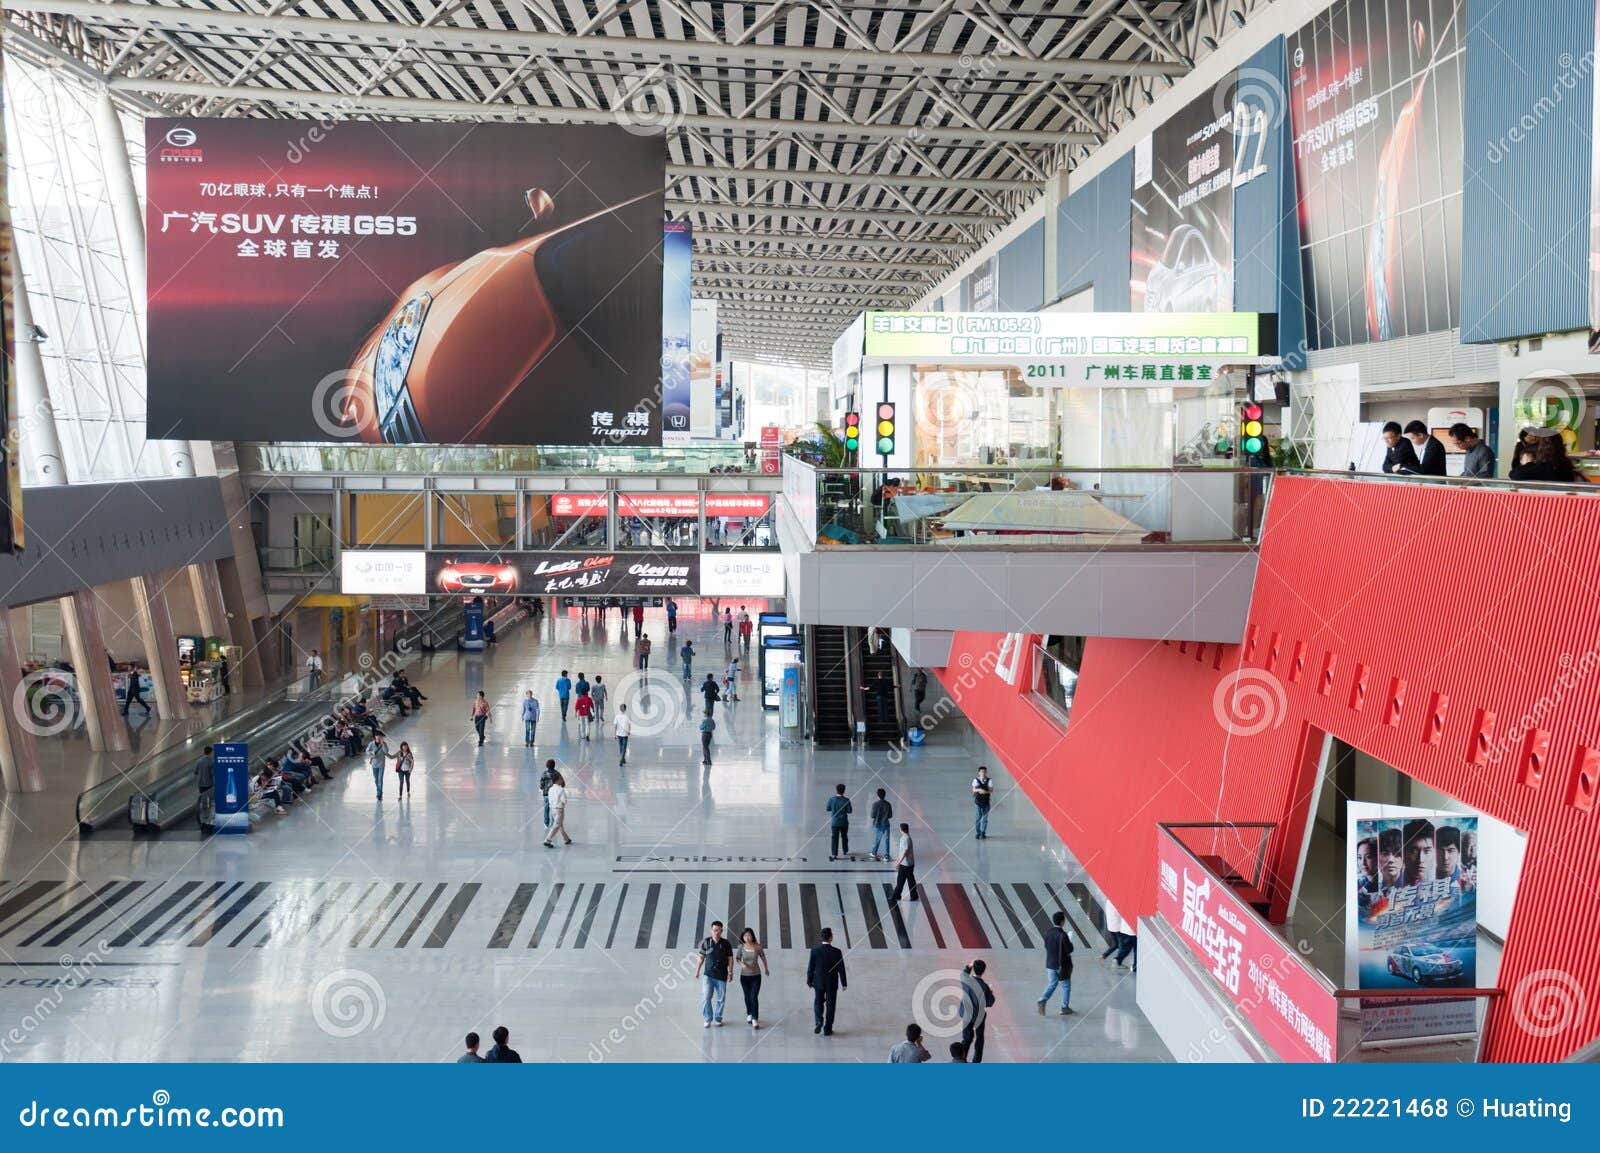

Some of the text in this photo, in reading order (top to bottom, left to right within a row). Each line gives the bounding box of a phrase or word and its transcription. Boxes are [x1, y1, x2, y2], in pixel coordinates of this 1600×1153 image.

[237, 238, 340, 259] 全球首发
[1027, 364, 1212, 381] 2011 广州车展直播室
[591, 411, 649, 427] 传祺
[591, 427, 649, 436] Trumpchi
[616, 855, 808, 863] Exhibition
